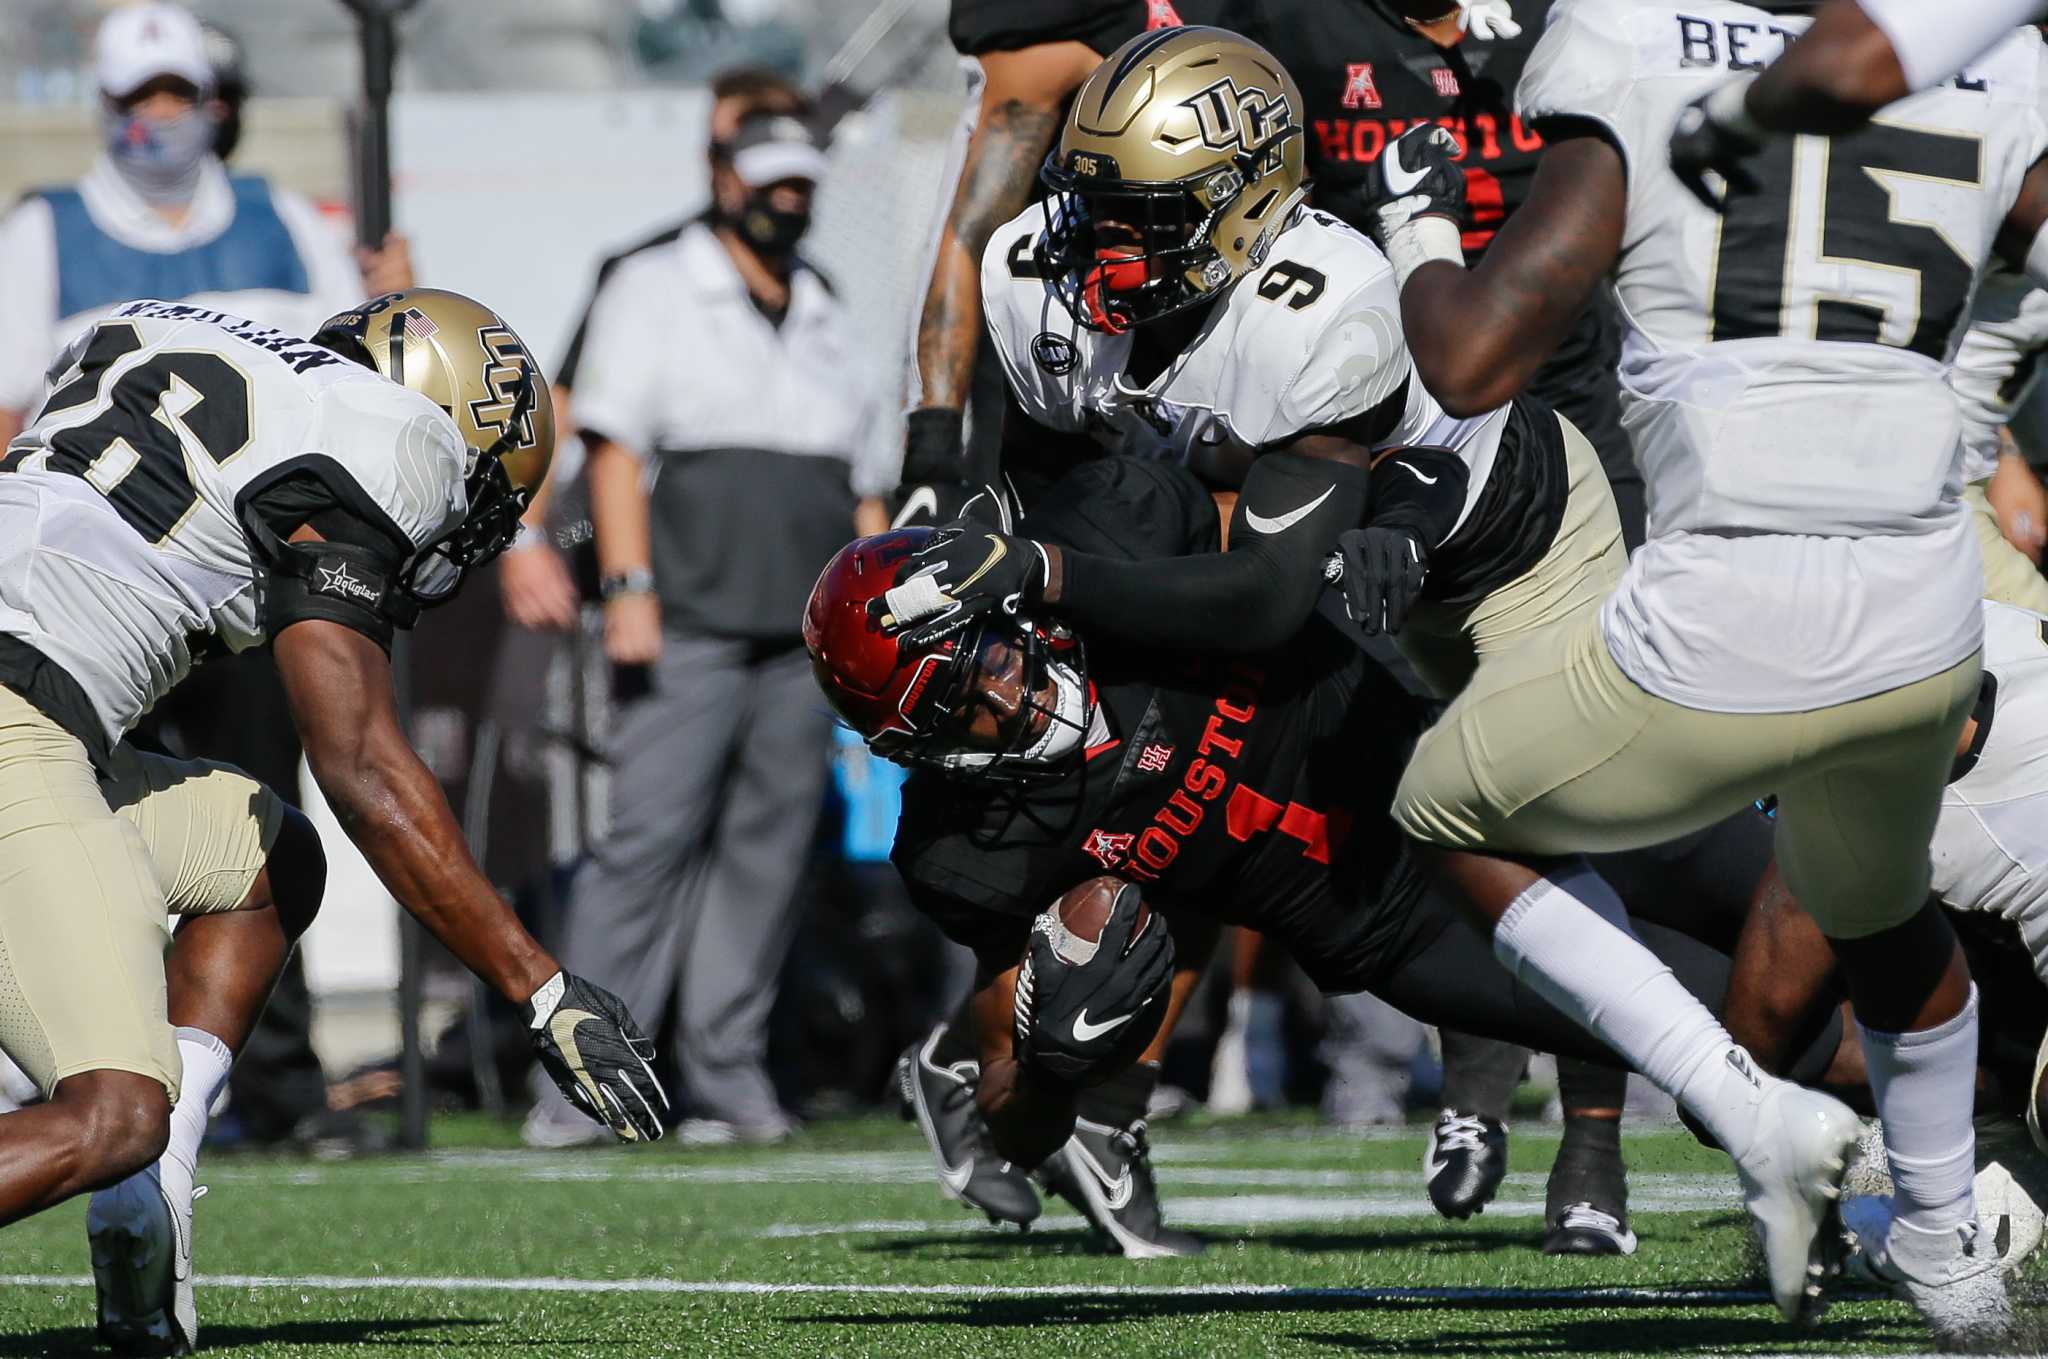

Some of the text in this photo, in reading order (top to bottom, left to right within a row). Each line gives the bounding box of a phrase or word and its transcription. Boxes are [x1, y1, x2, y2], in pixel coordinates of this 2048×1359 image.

[1175, 75, 1293, 177] UCF
[1073, 154, 1098, 177] 305
[1707, 118, 1982, 362] 15
[1256, 258, 1331, 314] 9
[332, 574, 378, 601] Douglas
